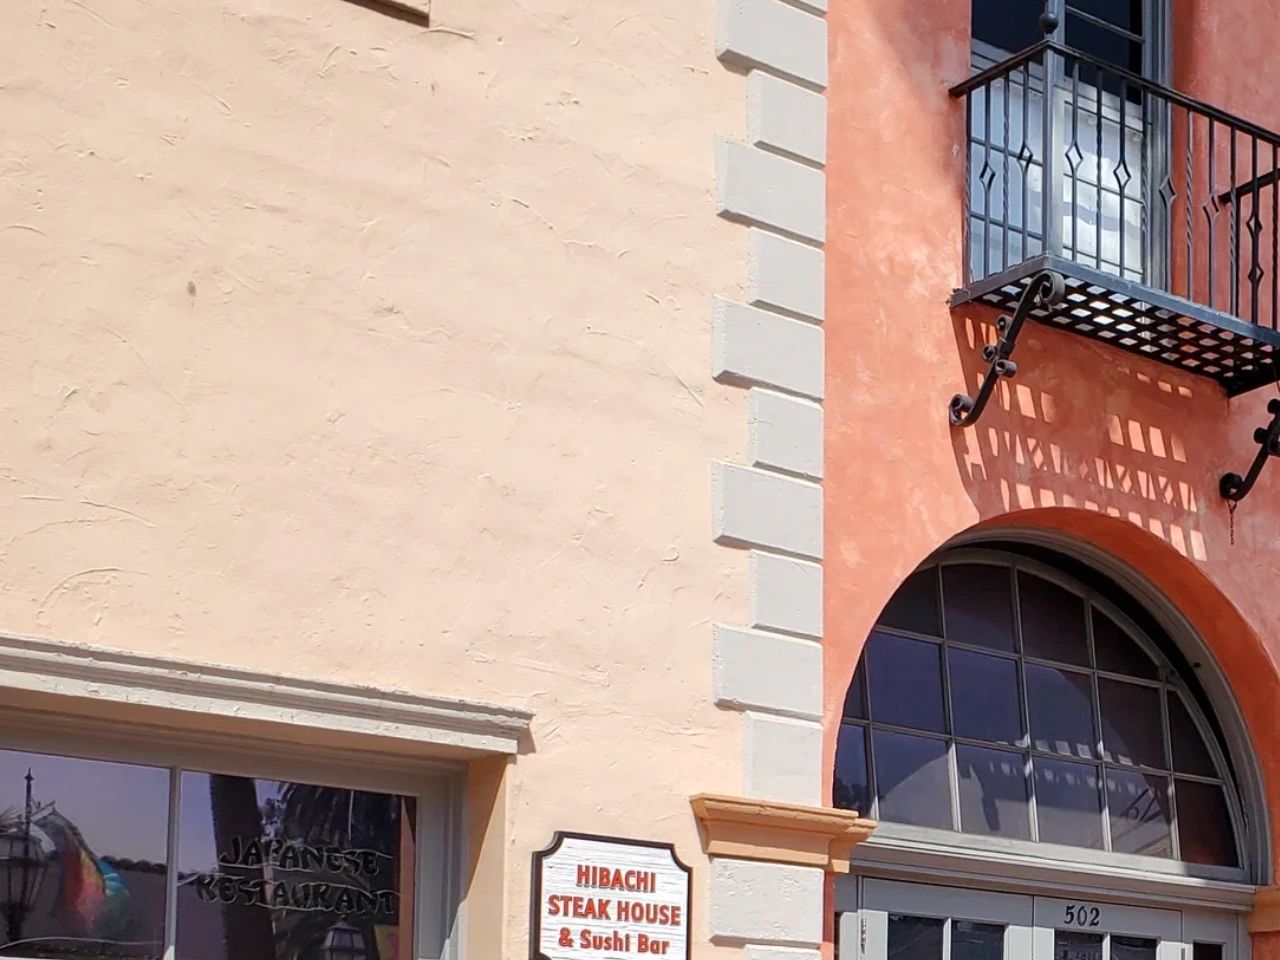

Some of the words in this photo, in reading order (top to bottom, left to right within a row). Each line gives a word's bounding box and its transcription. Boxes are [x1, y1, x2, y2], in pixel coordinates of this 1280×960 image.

[219, 835, 380, 876] JAPANESE
[196, 873, 395, 914] RESTAURANT
[575, 864, 657, 893] HIBACHI
[548, 894, 611, 921] STEAK
[616, 900, 681, 926] HOUSE
[1063, 904, 1100, 927] 502
[558, 927, 574, 948] &
[580, 929, 631, 952] Sushi
[637, 933, 670, 955] Bar
